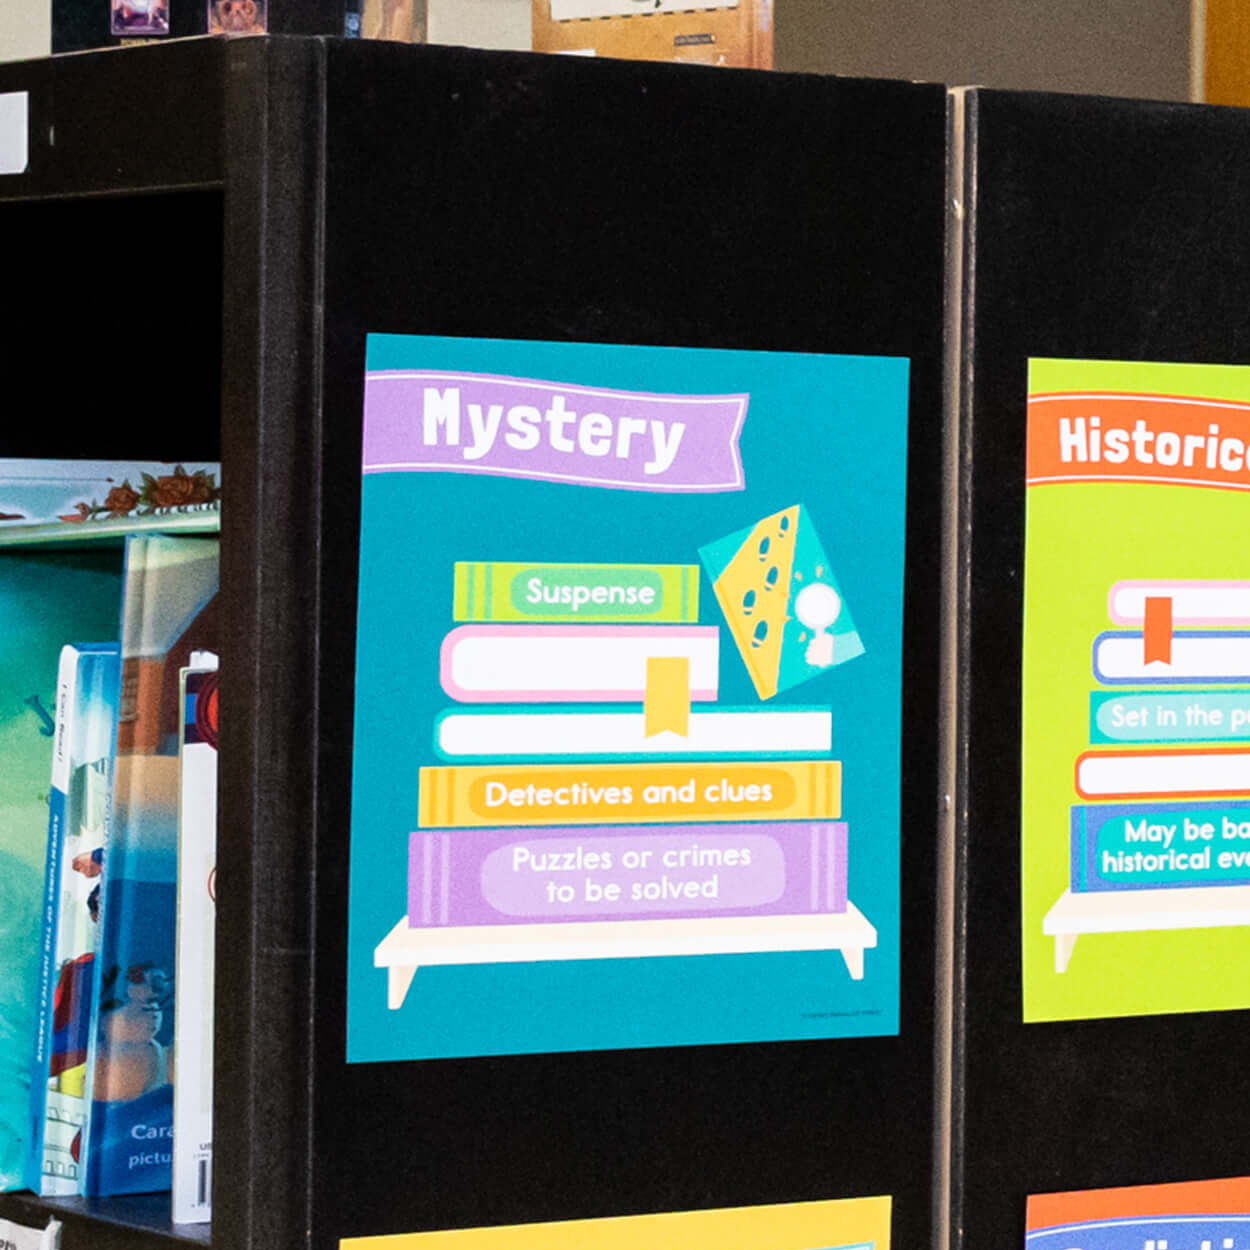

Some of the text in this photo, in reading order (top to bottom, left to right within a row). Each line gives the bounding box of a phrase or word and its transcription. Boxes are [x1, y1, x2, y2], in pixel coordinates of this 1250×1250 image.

[423, 388, 685, 474] Mystery
[526, 579, 655, 610] Suspense
[1111, 705, 1147, 727] Set
[1156, 704, 1177, 726] in
[1186, 704, 1223, 726] the
[485, 778, 773, 807] Detectives and clues
[1125, 819, 1175, 848] May
[1184, 817, 1215, 841] be
[512, 844, 752, 871] Puzzles or crimes
[1103, 848, 1210, 873] historical
[546, 875, 719, 903] to be solved
[37, 1010, 46, 1062] LEAGUE
